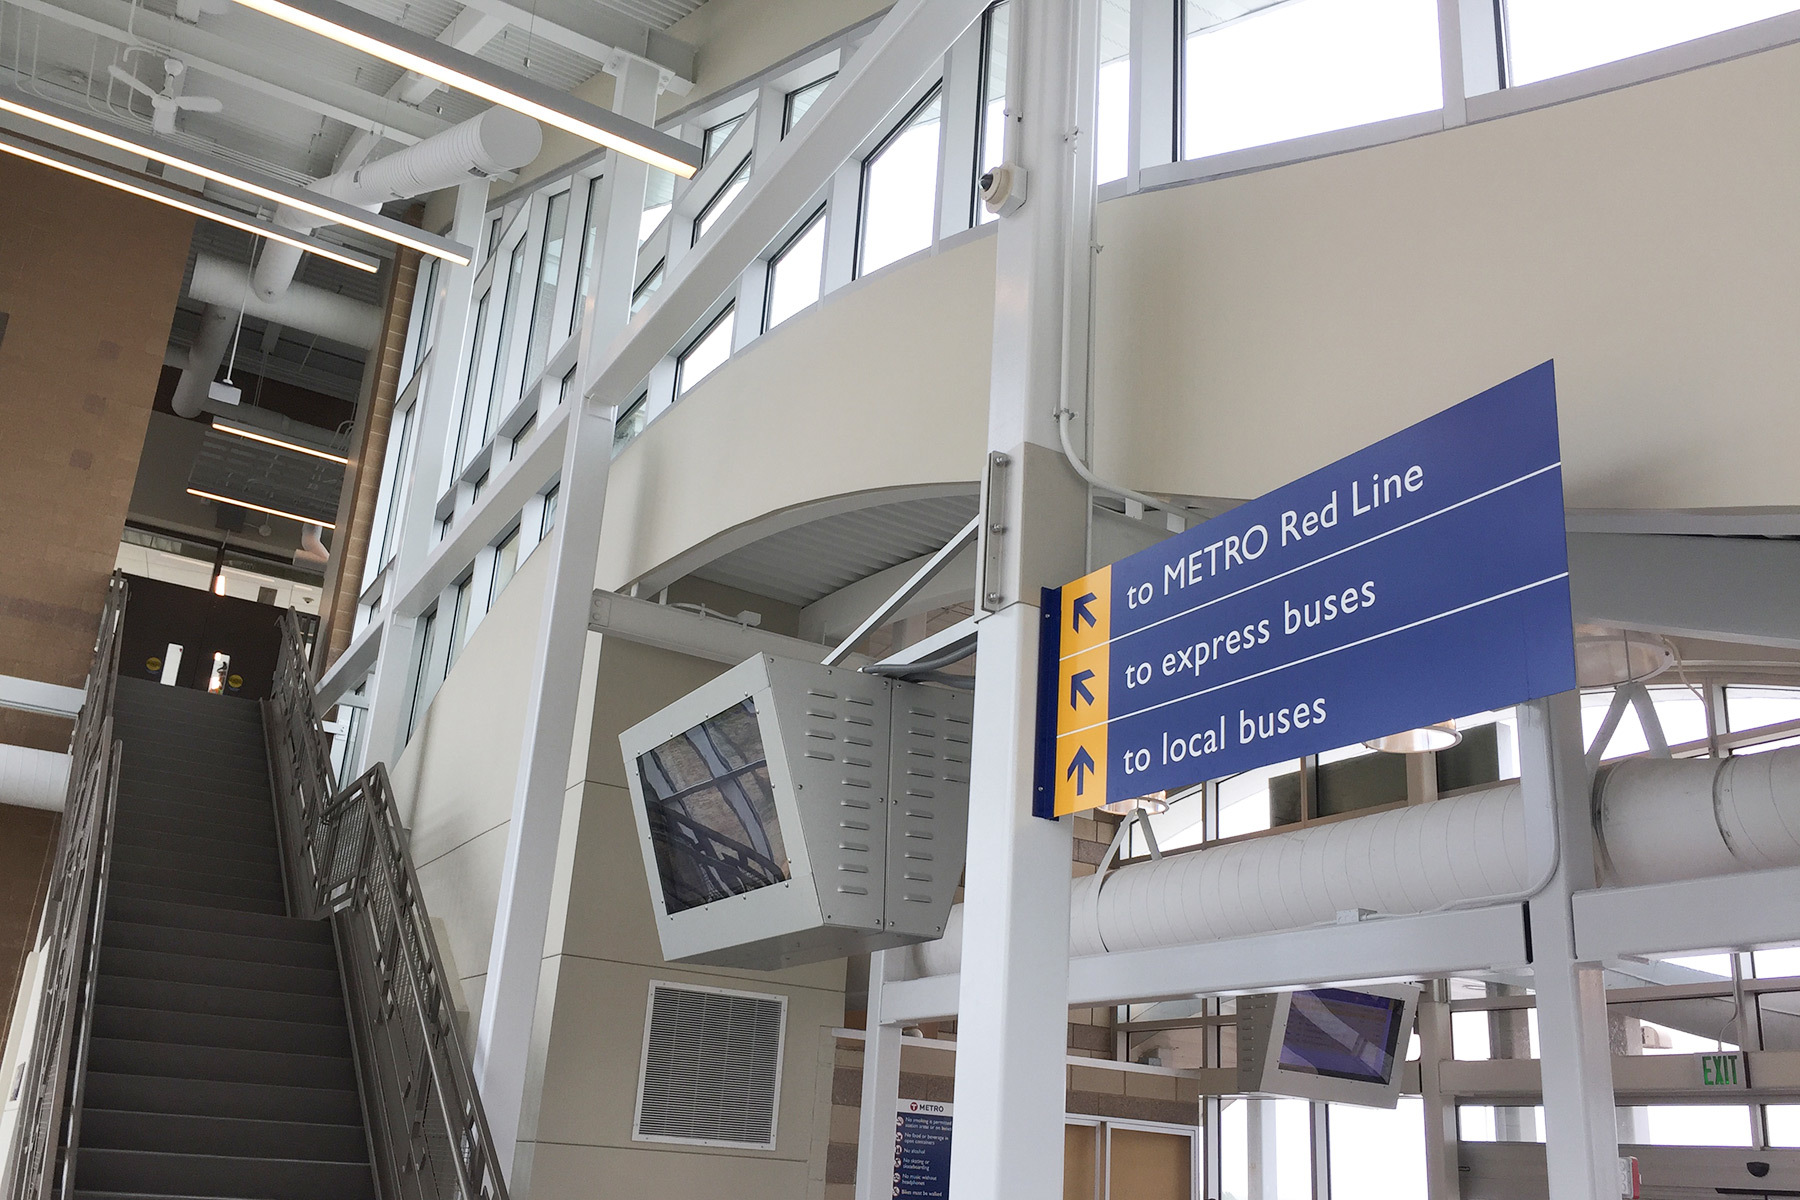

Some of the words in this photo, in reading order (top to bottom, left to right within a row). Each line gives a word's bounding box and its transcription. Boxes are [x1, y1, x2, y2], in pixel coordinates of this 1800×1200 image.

[1126, 582, 1154, 610] to
[1163, 524, 1269, 596] METRO
[1280, 490, 1339, 547] Red
[1351, 465, 1424, 517] Line
[1125, 662, 1152, 689] to
[1161, 619, 1270, 677] express
[1283, 580, 1377, 635] buses
[1123, 749, 1151, 776] to
[1161, 715, 1226, 765] local
[1239, 697, 1328, 745] buses
[919, 1104, 944, 1112] METRO
[1702, 1055, 1737, 1085] EXIT
